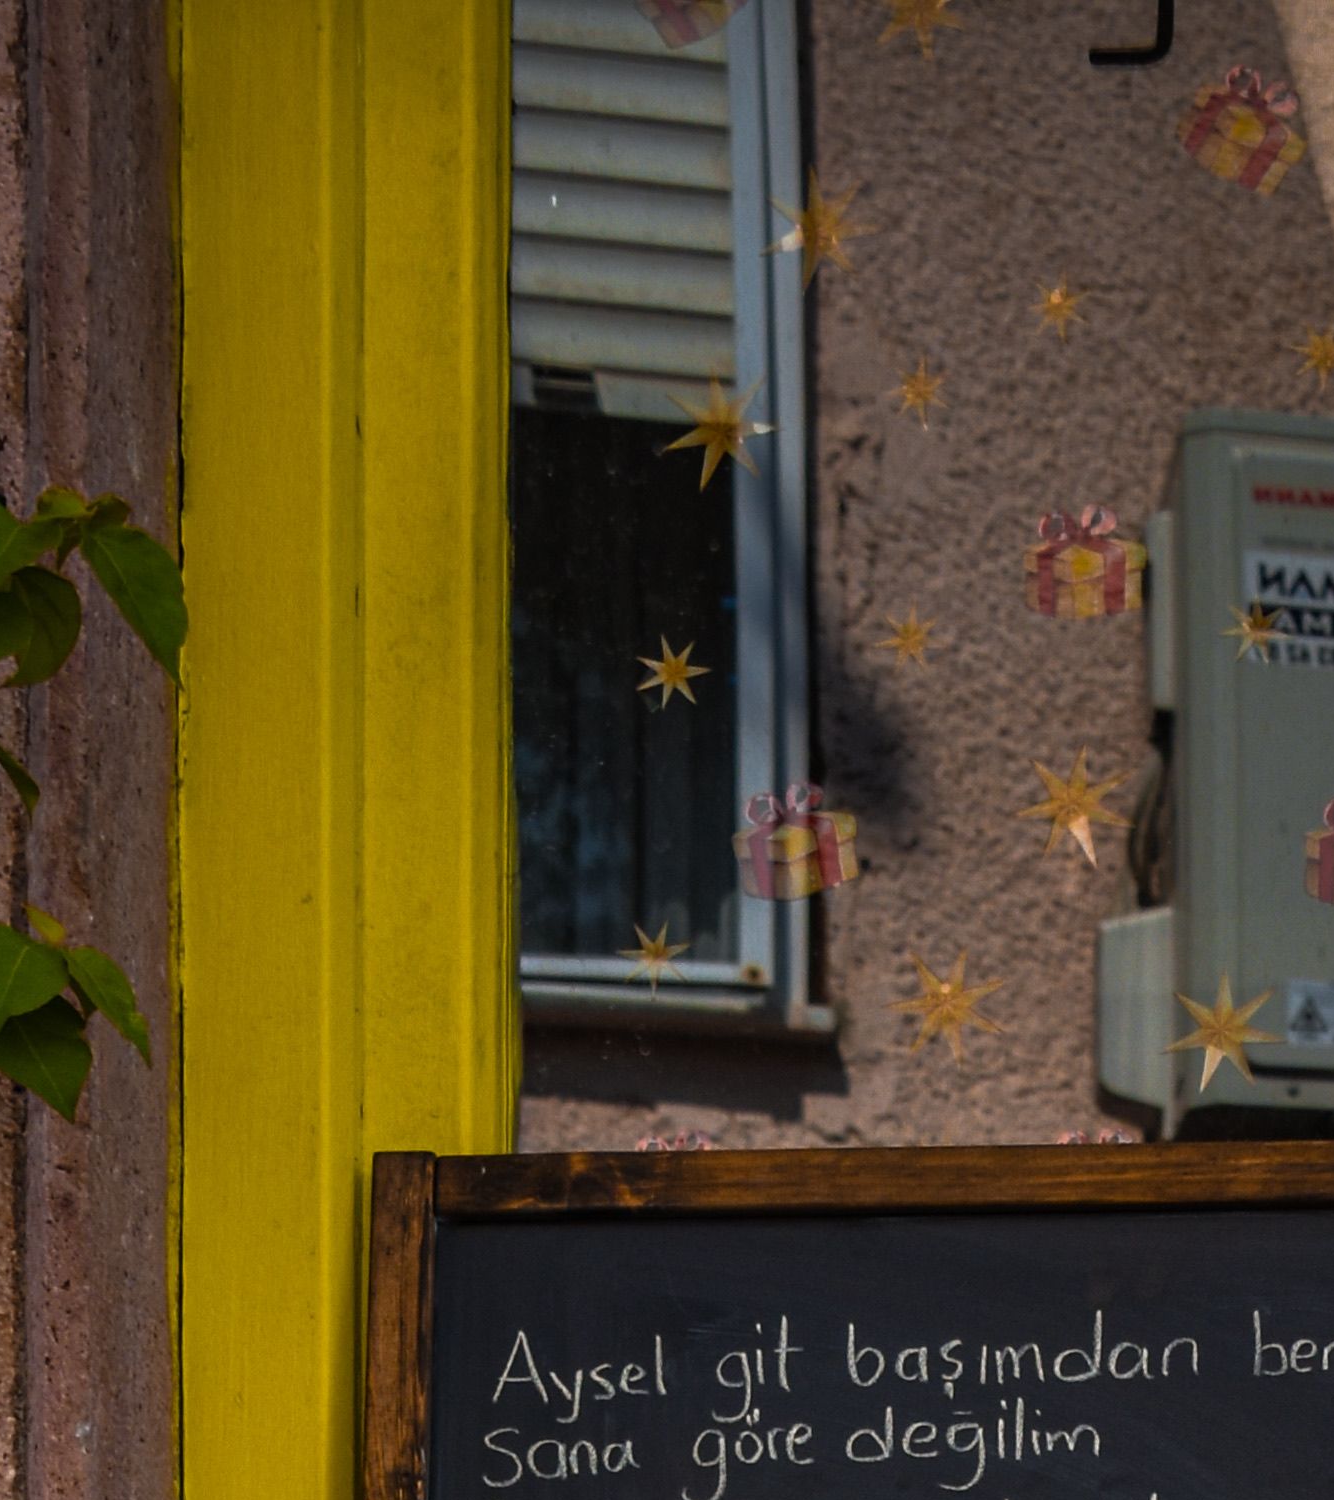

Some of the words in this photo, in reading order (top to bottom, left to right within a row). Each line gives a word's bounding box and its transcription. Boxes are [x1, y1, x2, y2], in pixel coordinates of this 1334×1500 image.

[493, 1331, 667, 1424] Aysel
[713, 1315, 804, 1423] git
[848, 1310, 1199, 1399] başımdan
[847, 1397, 1100, 1491] değilim
